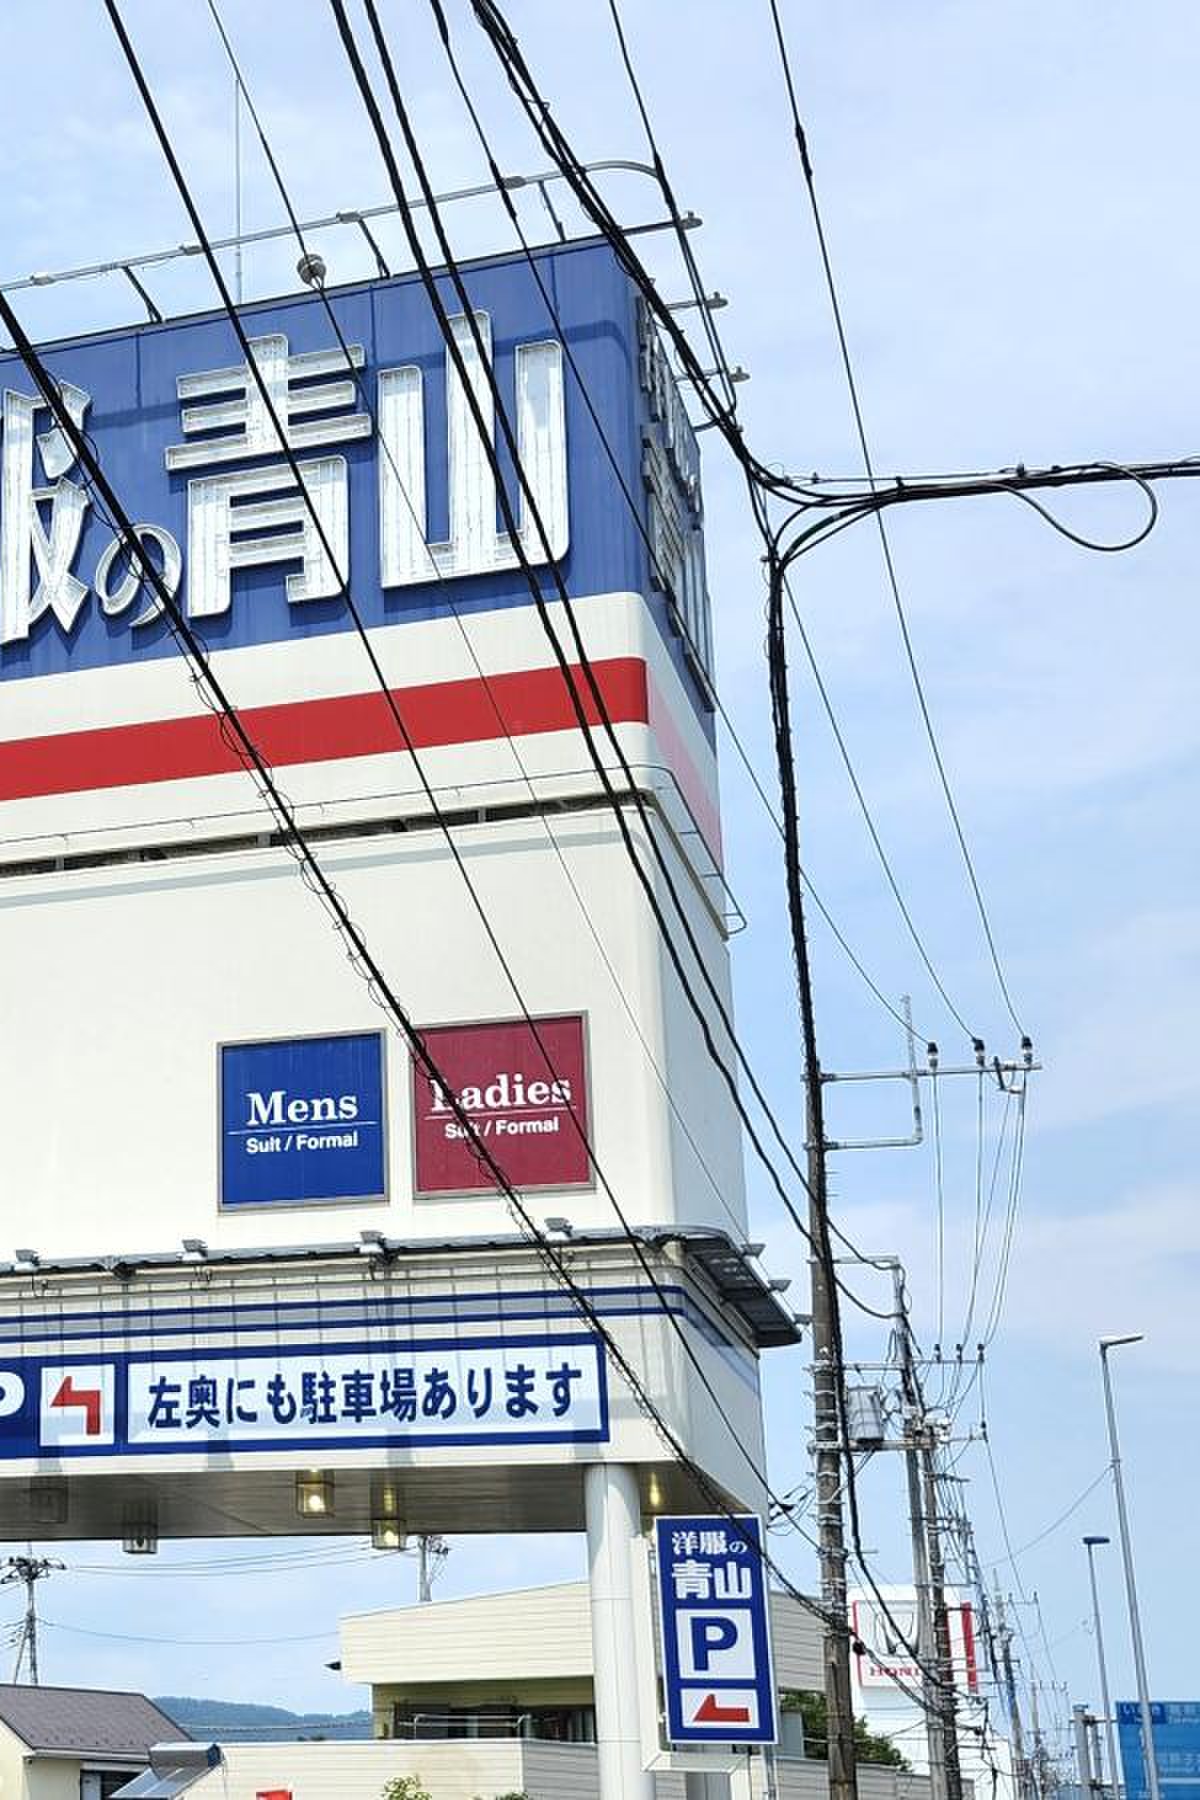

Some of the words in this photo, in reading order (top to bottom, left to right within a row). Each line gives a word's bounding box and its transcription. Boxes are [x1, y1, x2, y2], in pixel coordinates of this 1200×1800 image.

[246, 1090, 358, 1126] Mens
[430, 1073, 571, 1112] Ladies
[246, 1135, 281, 1153] Suit
[297, 1131, 358, 1150] Formal
[445, 1121, 480, 1139] Sut
[495, 1116, 559, 1135] Formal
[147, 1362, 582, 1429] 左奥にも駐車場あります
[672, 1530, 748, 1556] 洋服の
[671, 1558, 753, 1600] 青山
[690, 1616, 738, 1671] P
